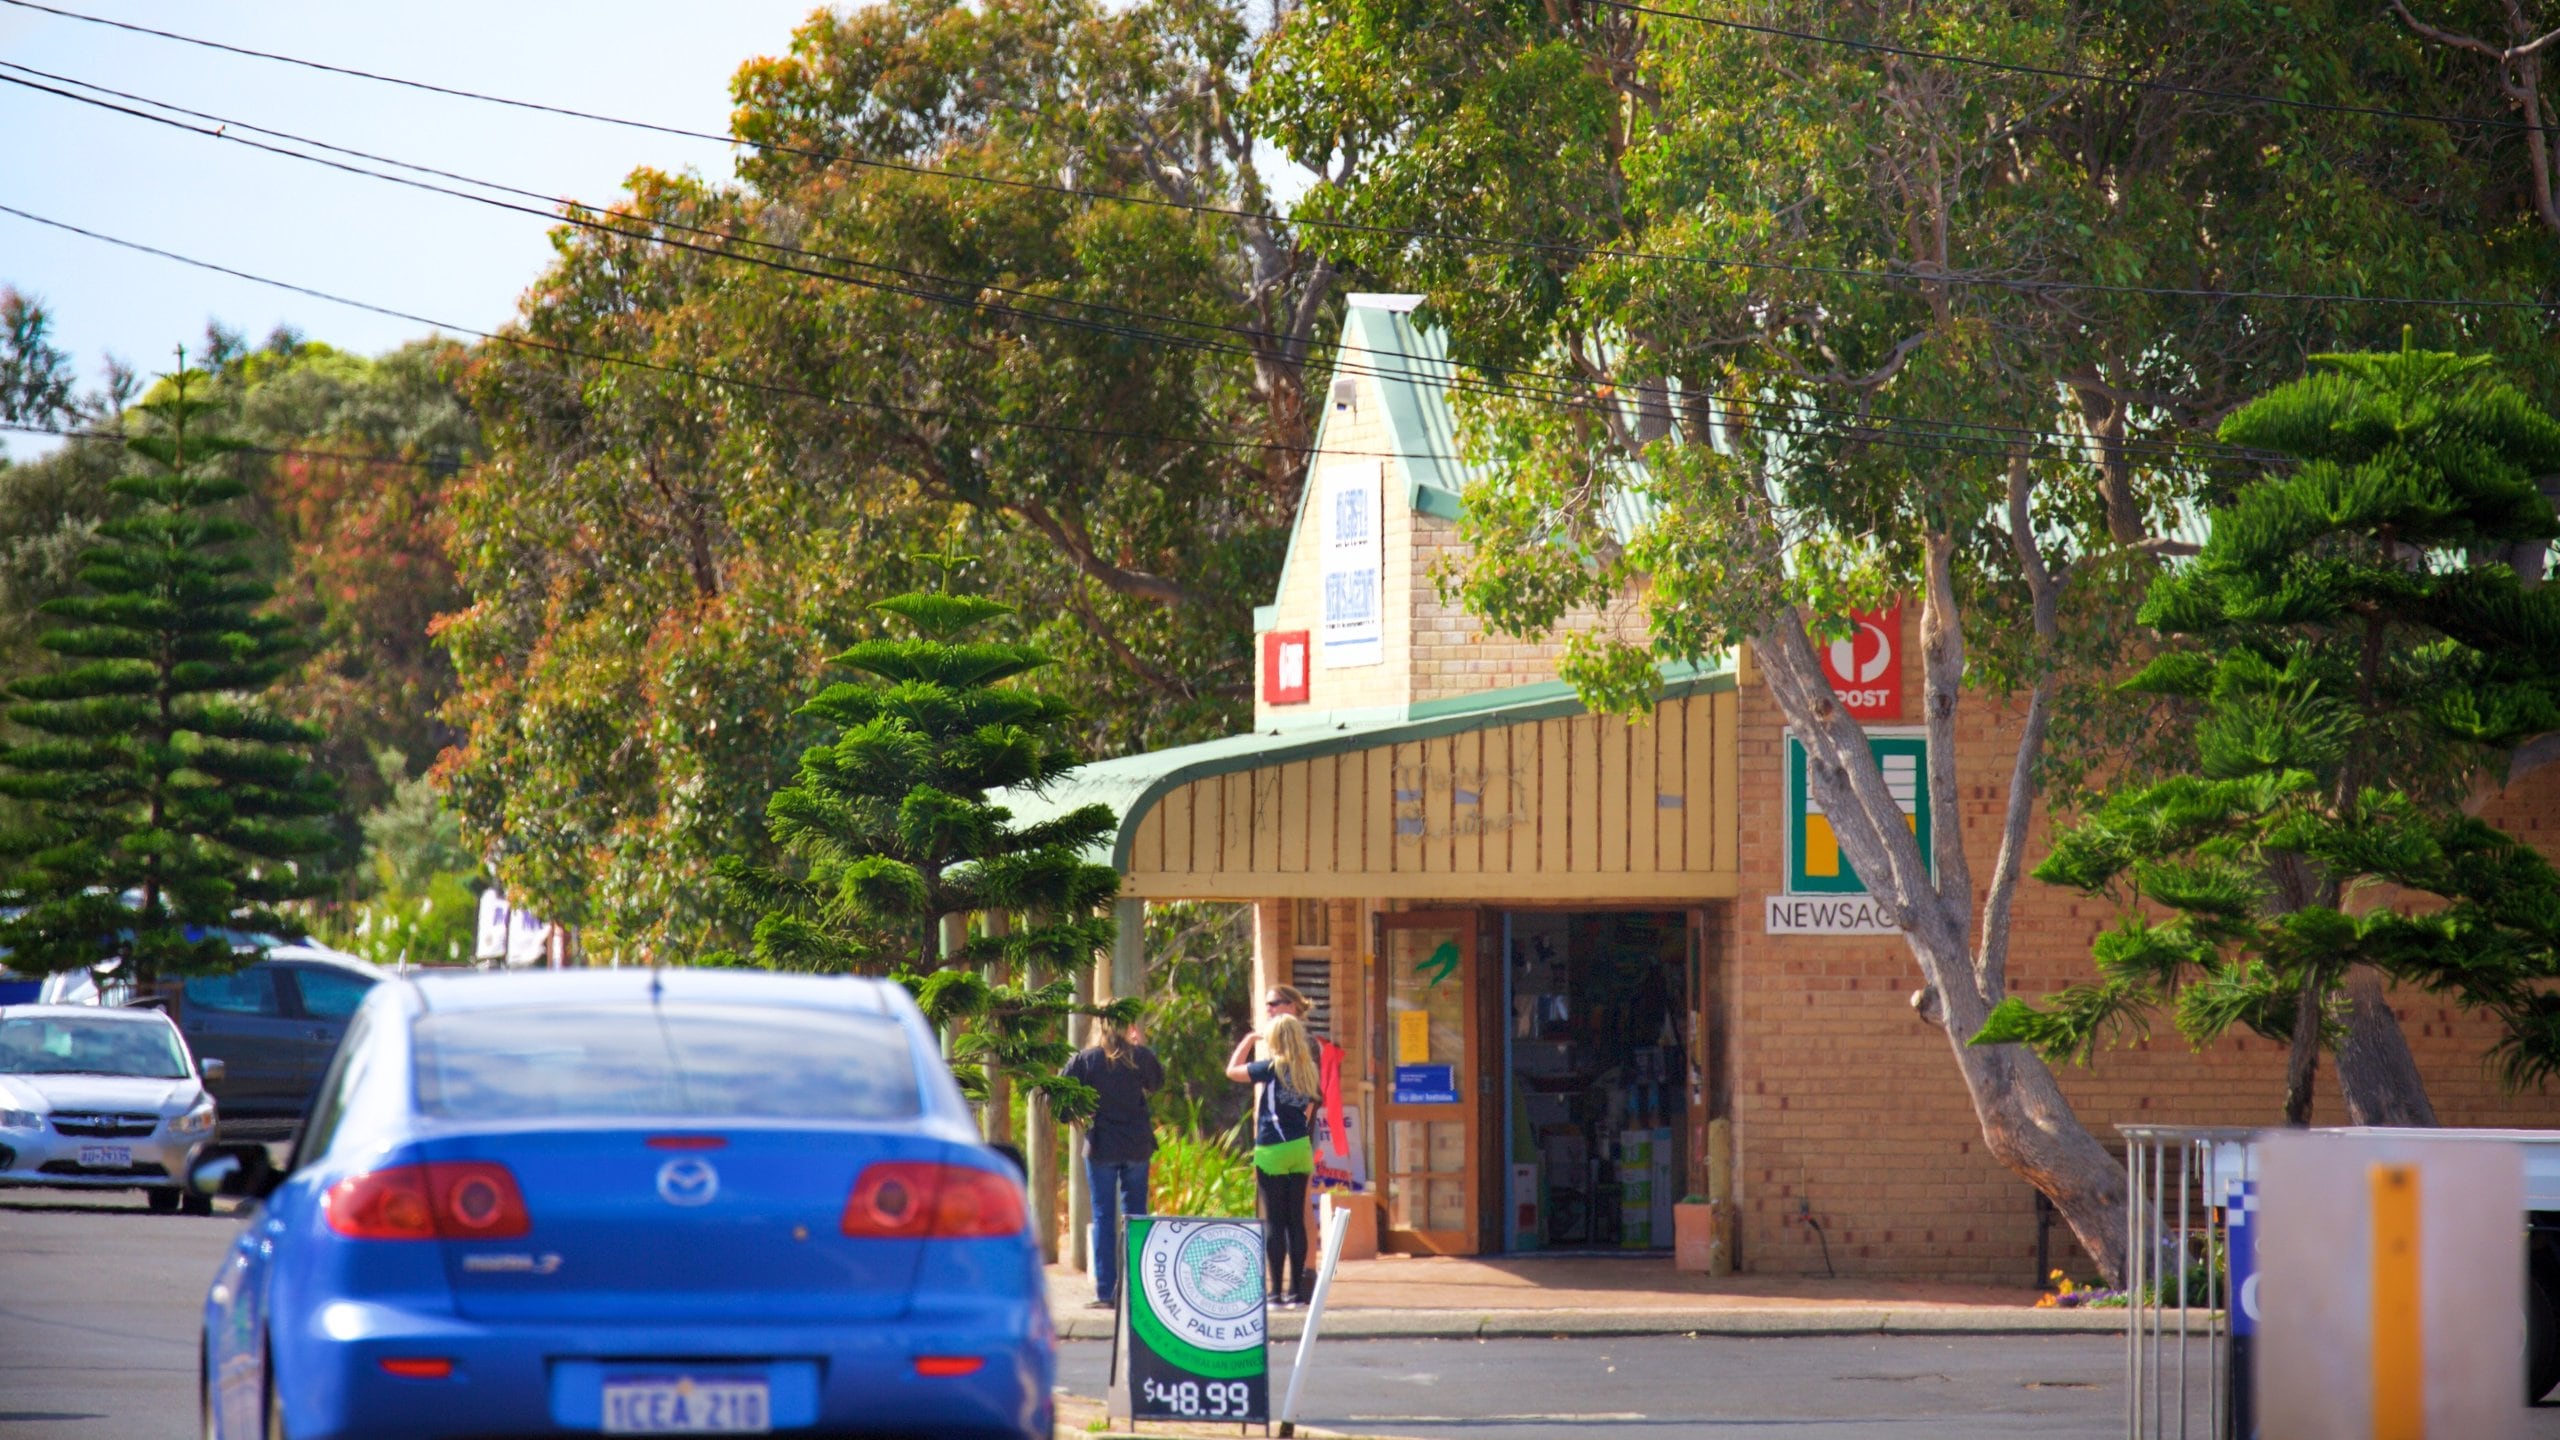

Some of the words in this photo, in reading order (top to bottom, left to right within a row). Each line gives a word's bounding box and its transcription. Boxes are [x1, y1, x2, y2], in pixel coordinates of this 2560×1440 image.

[1833, 689, 1890, 707] POST
[1154, 1251, 1181, 1322] ORIGINAL
[1187, 1317, 1225, 1340] PALE
[1233, 1318, 1263, 1340] ALE
[1143, 1377, 1249, 1416] $48.99
